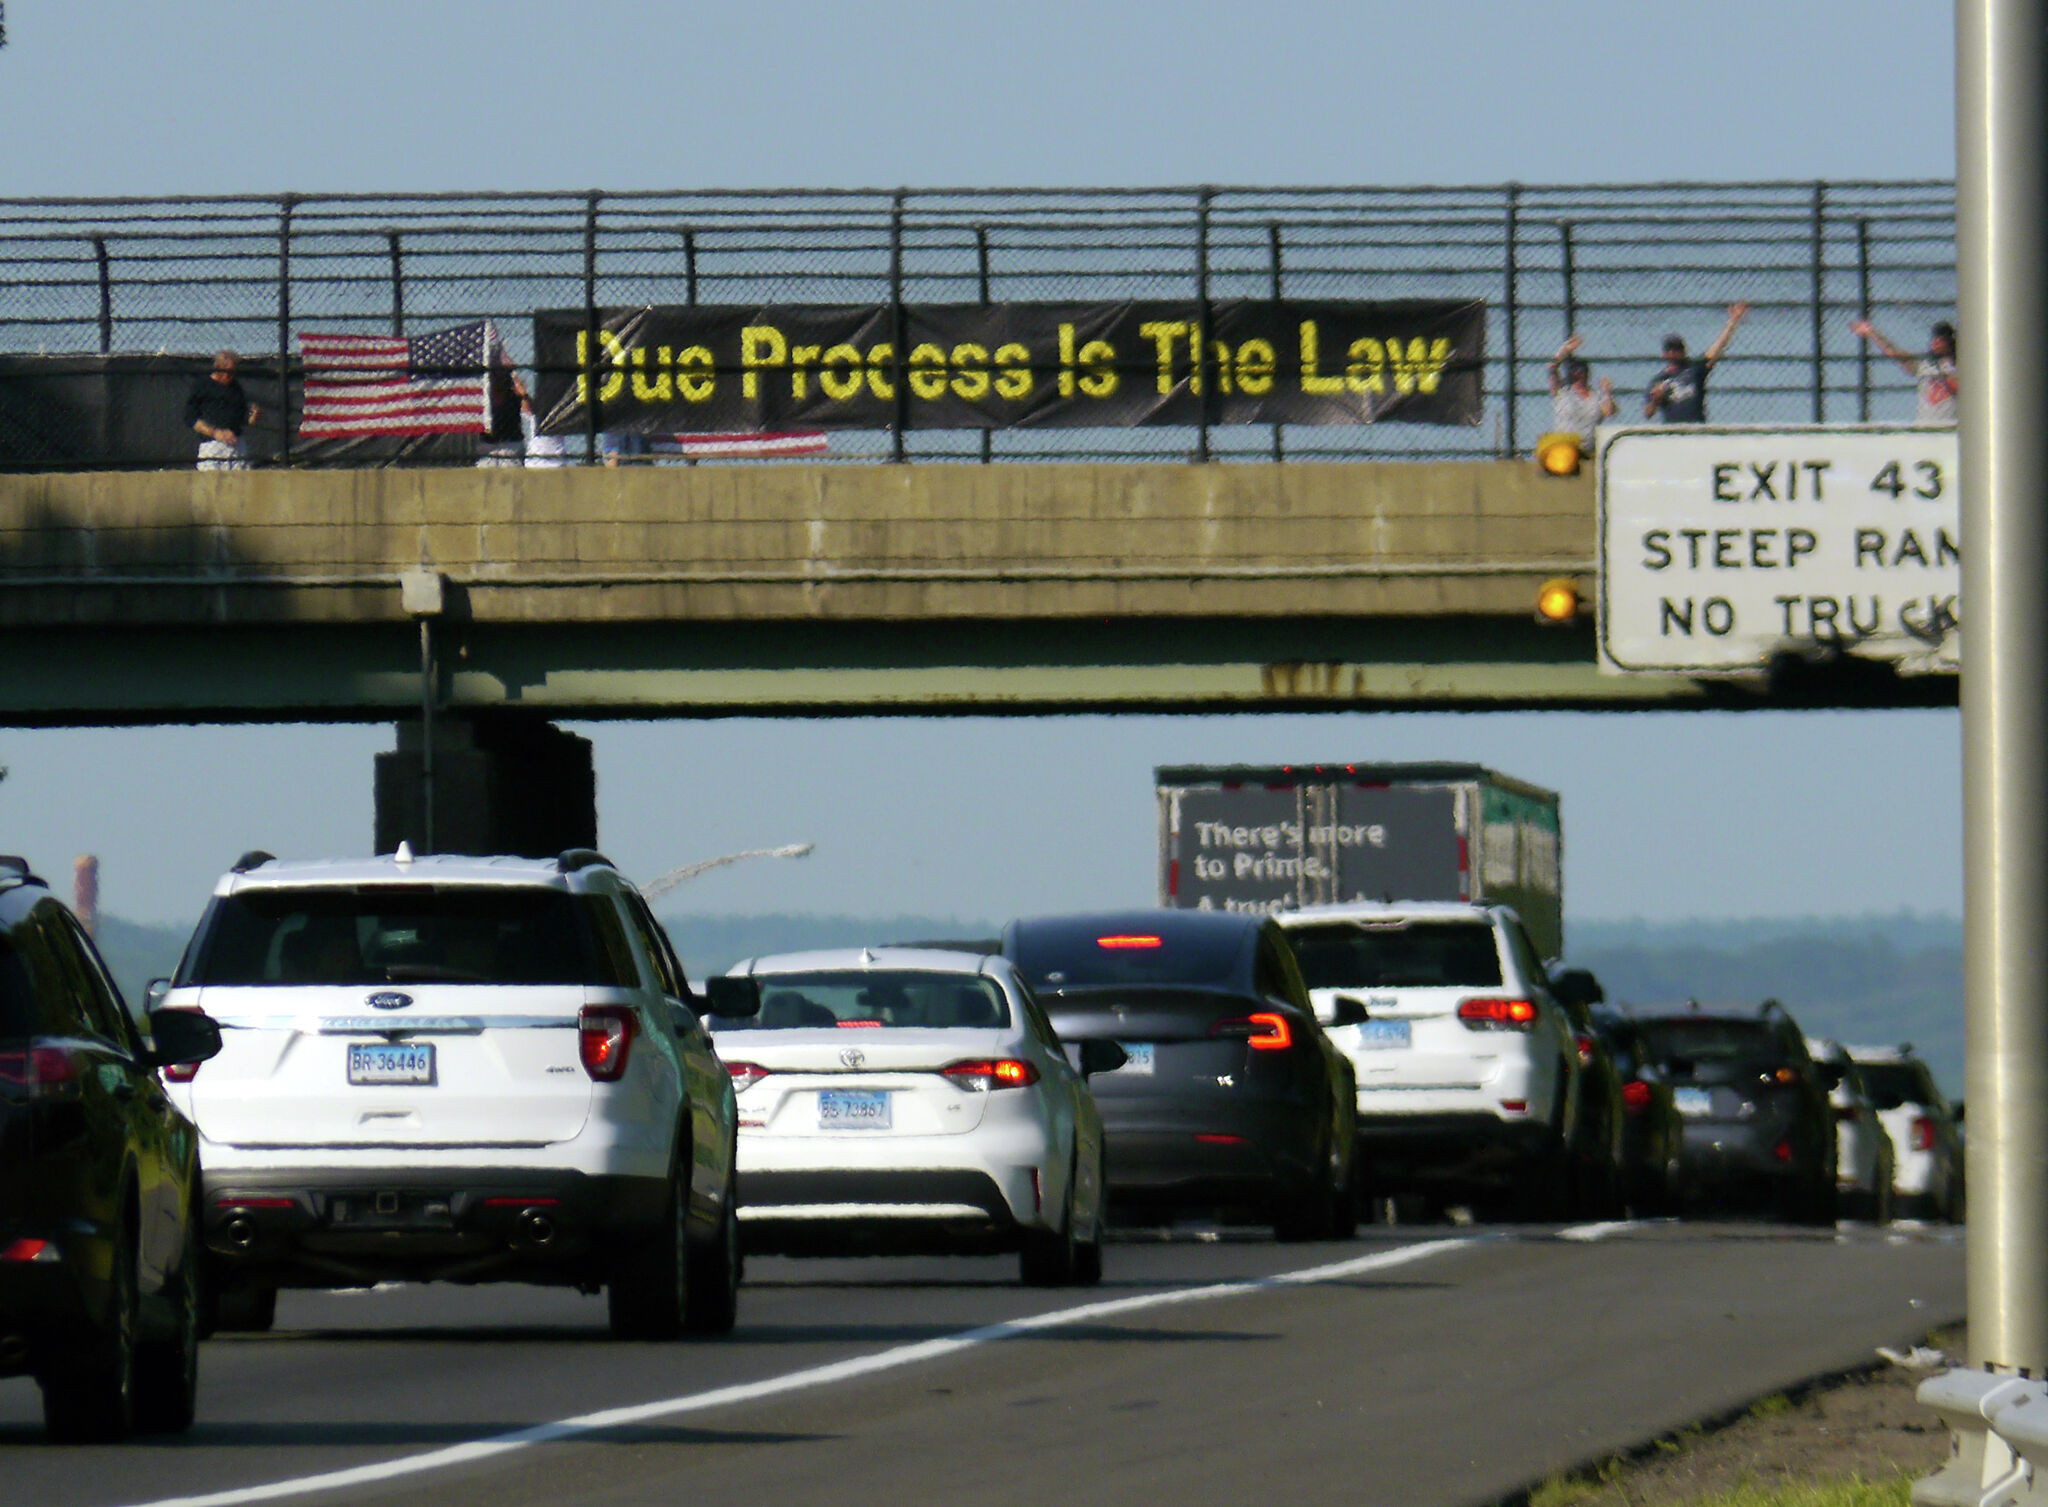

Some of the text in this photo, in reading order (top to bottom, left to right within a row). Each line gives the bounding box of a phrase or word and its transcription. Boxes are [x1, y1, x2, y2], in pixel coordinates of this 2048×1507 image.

[576, 319, 1451, 402] Due Process Is The Law
[1712, 459, 1943, 501] EXIT 43
[1640, 528, 1818, 569] STEEP
[1660, 597, 1735, 636] NO
[1194, 821, 1386, 848] There's more
[1194, 851, 1330, 880] to Prime.
